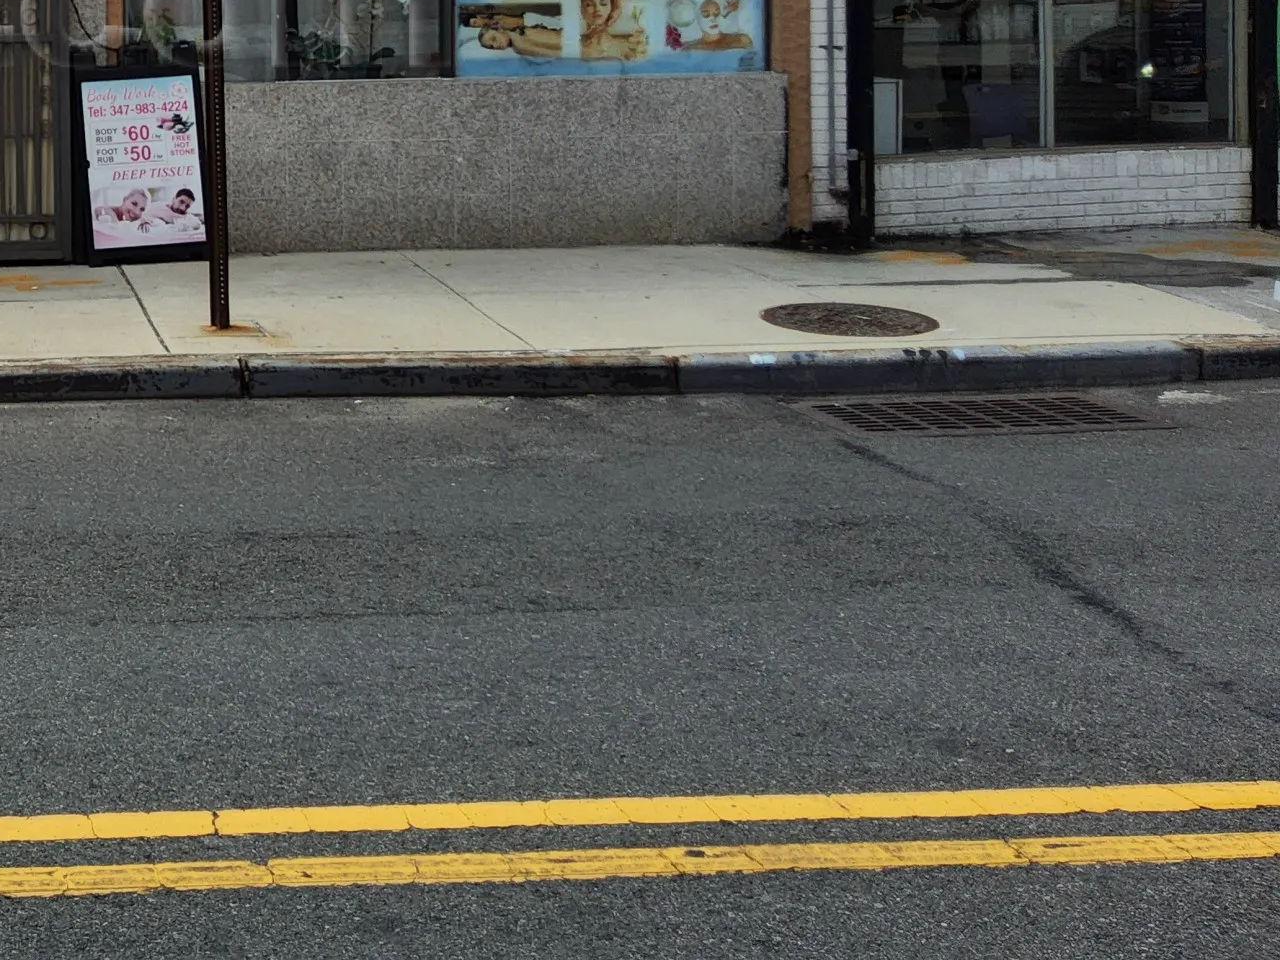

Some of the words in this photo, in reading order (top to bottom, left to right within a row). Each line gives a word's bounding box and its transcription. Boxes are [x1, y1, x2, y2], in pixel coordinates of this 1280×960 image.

[86, 88, 118, 106] Body
[122, 84, 155, 101] Work
[88, 106, 106, 118] Tel:
[109, 100, 188, 116] 347-983-4224
[95, 128, 117, 136] BODY
[96, 148, 118, 156] FOOT
[170, 148, 196, 156] STONE
[112, 169, 146, 181] DEEP
[150, 166, 194, 178] TISSUE
